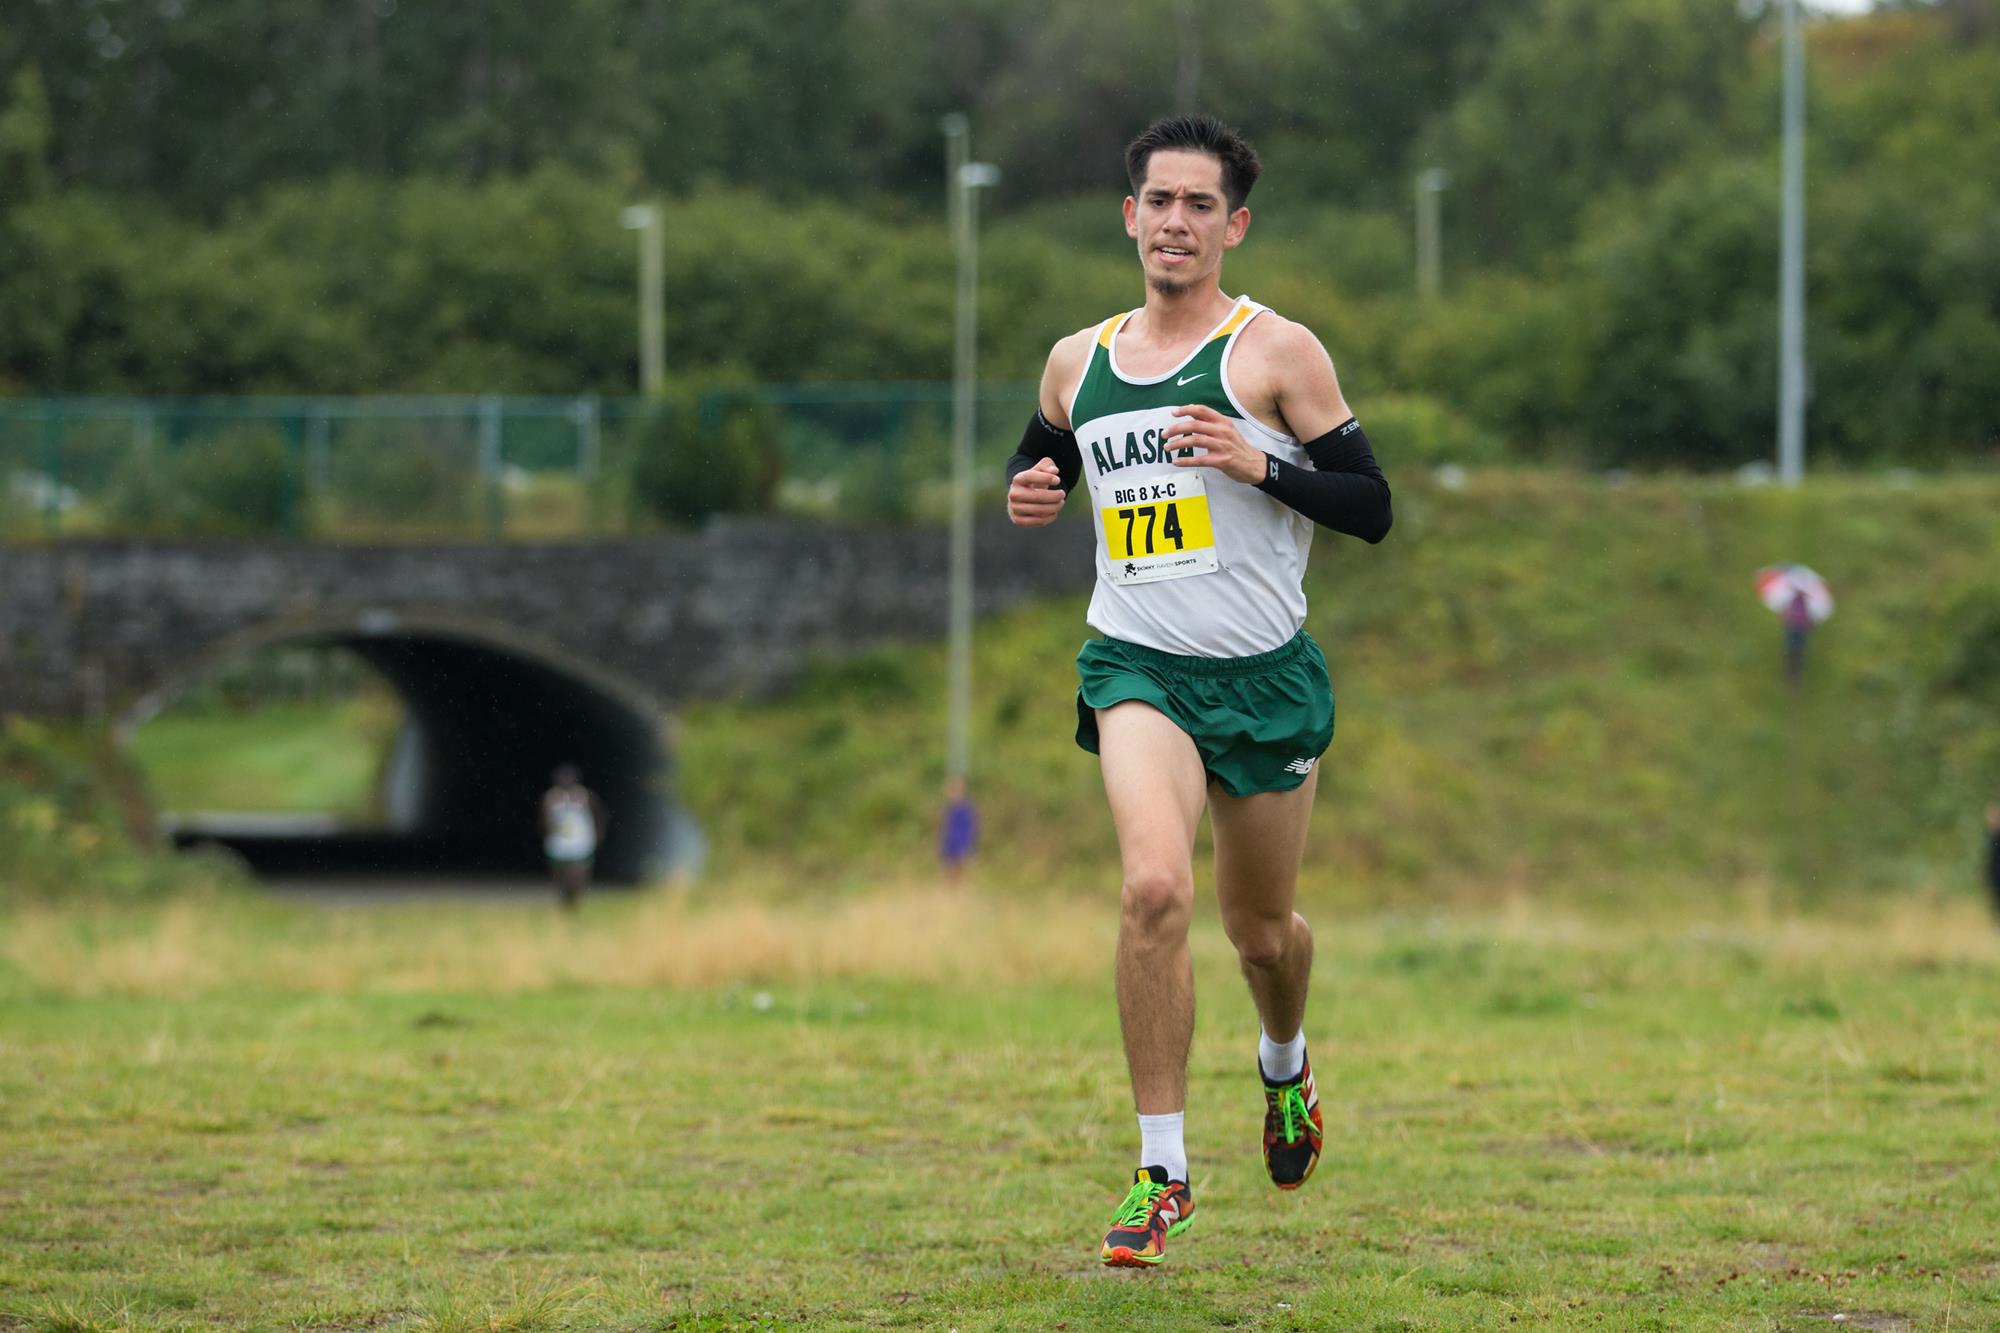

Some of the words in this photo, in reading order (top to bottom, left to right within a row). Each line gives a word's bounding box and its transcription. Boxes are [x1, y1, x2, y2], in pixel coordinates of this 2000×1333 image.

[1115, 488, 1136, 504] BIG
[1140, 487, 1148, 501] 8
[1151, 483, 1177, 500] X-C
[1118, 503, 1183, 556] 774
[1174, 558, 1196, 566] SPORTS
